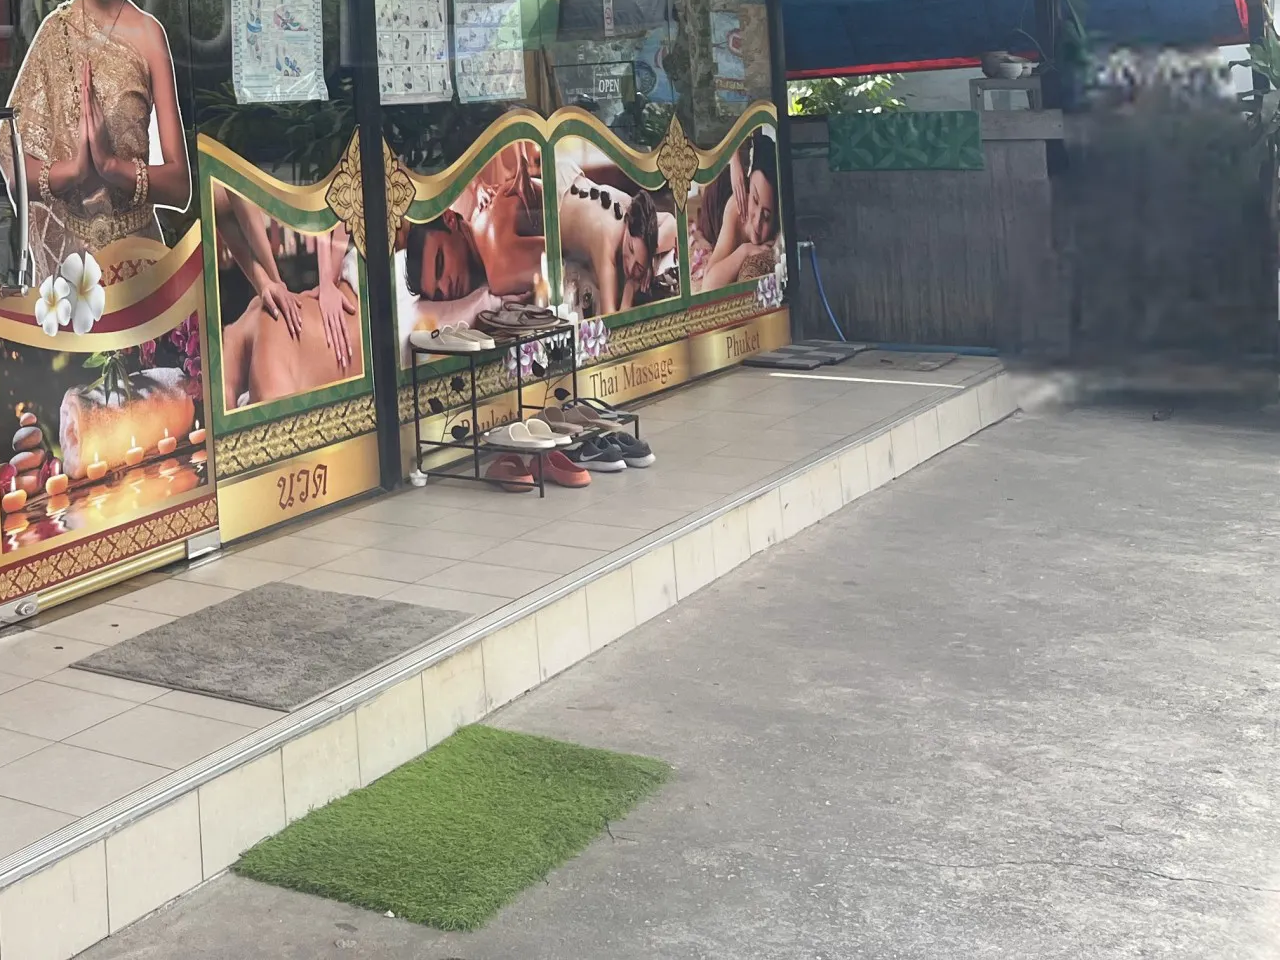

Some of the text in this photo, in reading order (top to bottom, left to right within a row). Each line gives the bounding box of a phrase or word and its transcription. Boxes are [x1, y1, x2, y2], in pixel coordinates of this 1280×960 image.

[598, 79, 620, 93] OPEN
[726, 331, 761, 359] Phuket
[589, 356, 674, 400] Thai Massage
[276, 463, 328, 510] นวด
